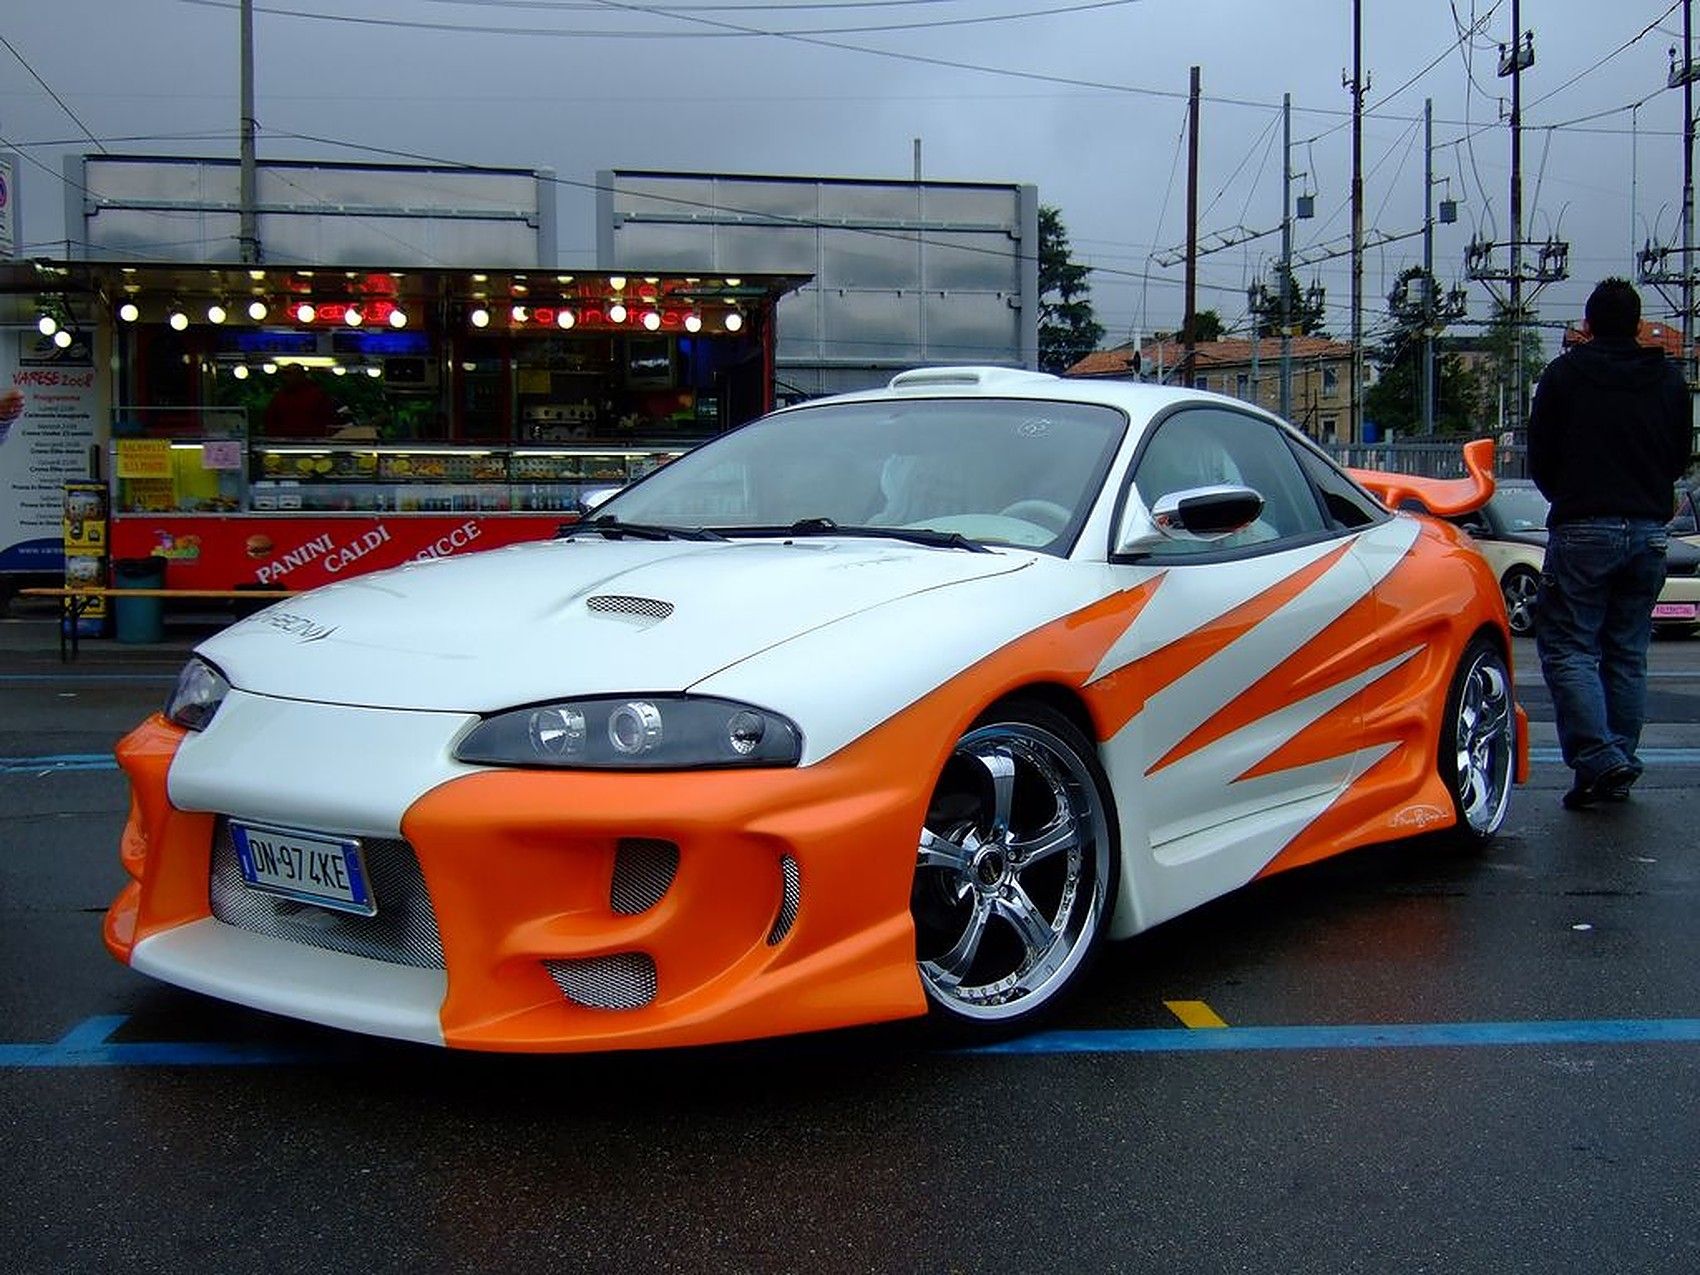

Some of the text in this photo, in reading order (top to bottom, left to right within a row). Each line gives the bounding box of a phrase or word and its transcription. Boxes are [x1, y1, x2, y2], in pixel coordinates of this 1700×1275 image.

[13, 371, 60, 386] VARESE
[256, 533, 336, 584] PANINI
[324, 525, 392, 573] CALDI
